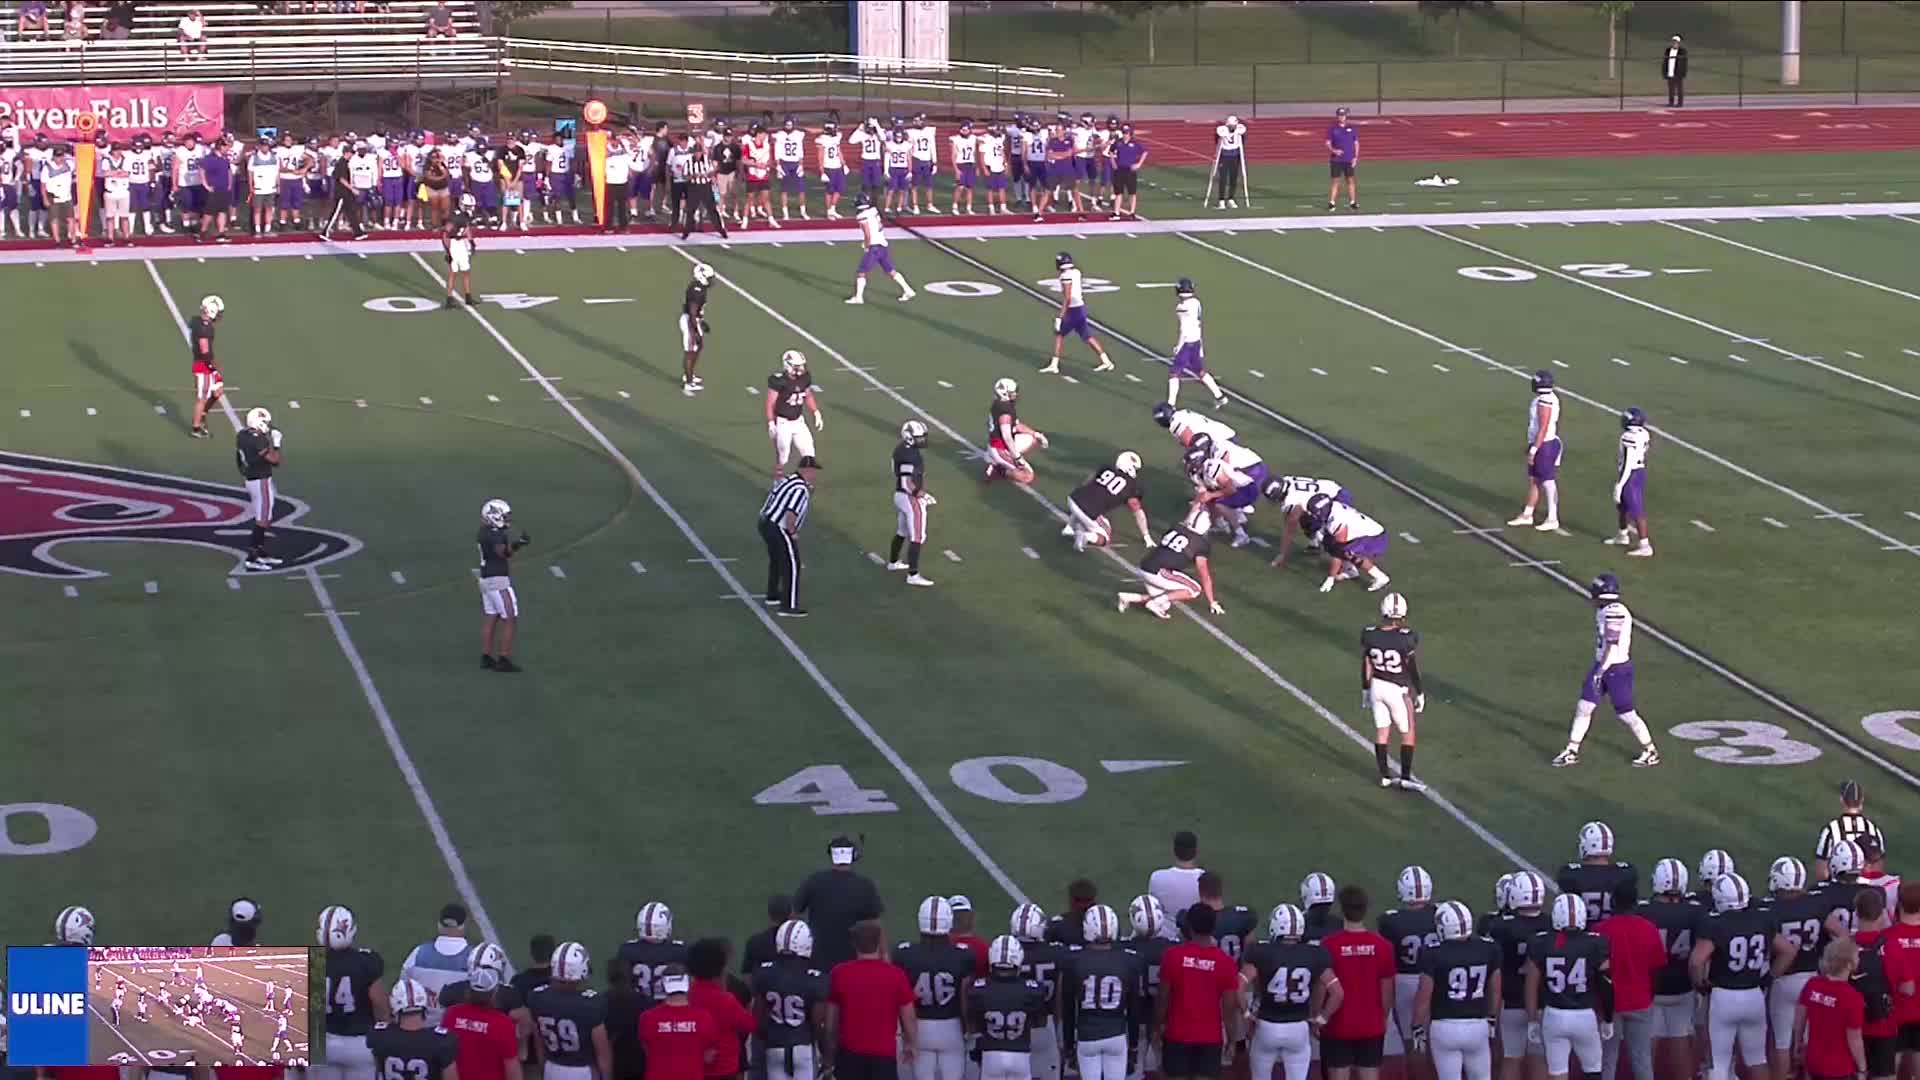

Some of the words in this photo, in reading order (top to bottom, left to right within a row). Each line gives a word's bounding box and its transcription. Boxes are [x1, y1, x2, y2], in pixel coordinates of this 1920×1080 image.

[89, 98, 168, 129] Falls
[687, 103, 704, 124] 3
[632, 149, 646, 163] 71
[784, 142, 798, 157] 82
[864, 139, 876, 154] 21
[916, 138, 929, 152] 13
[961, 146, 974, 161] 17
[1031, 141, 1044, 154] 14
[131, 161, 145, 175] 91
[383, 158, 398, 171] 90
[1096, 469, 1127, 496] 90
[1370, 647, 1403, 674] 22
[1781, 918, 1821, 952] 53
[1728, 934, 1767, 972] 93
[913, 971, 956, 1006] 46
[1267, 966, 1312, 1004] 43
[1448, 965, 1488, 1001] 97
[1546, 957, 1587, 993] 54
[1080, 975, 1123, 1010] 10
[766, 991, 805, 1027] 36
[537, 1015, 581, 1052] 59
[983, 1010, 1027, 1040] 29
[384, 1056, 429, 1080] 63
